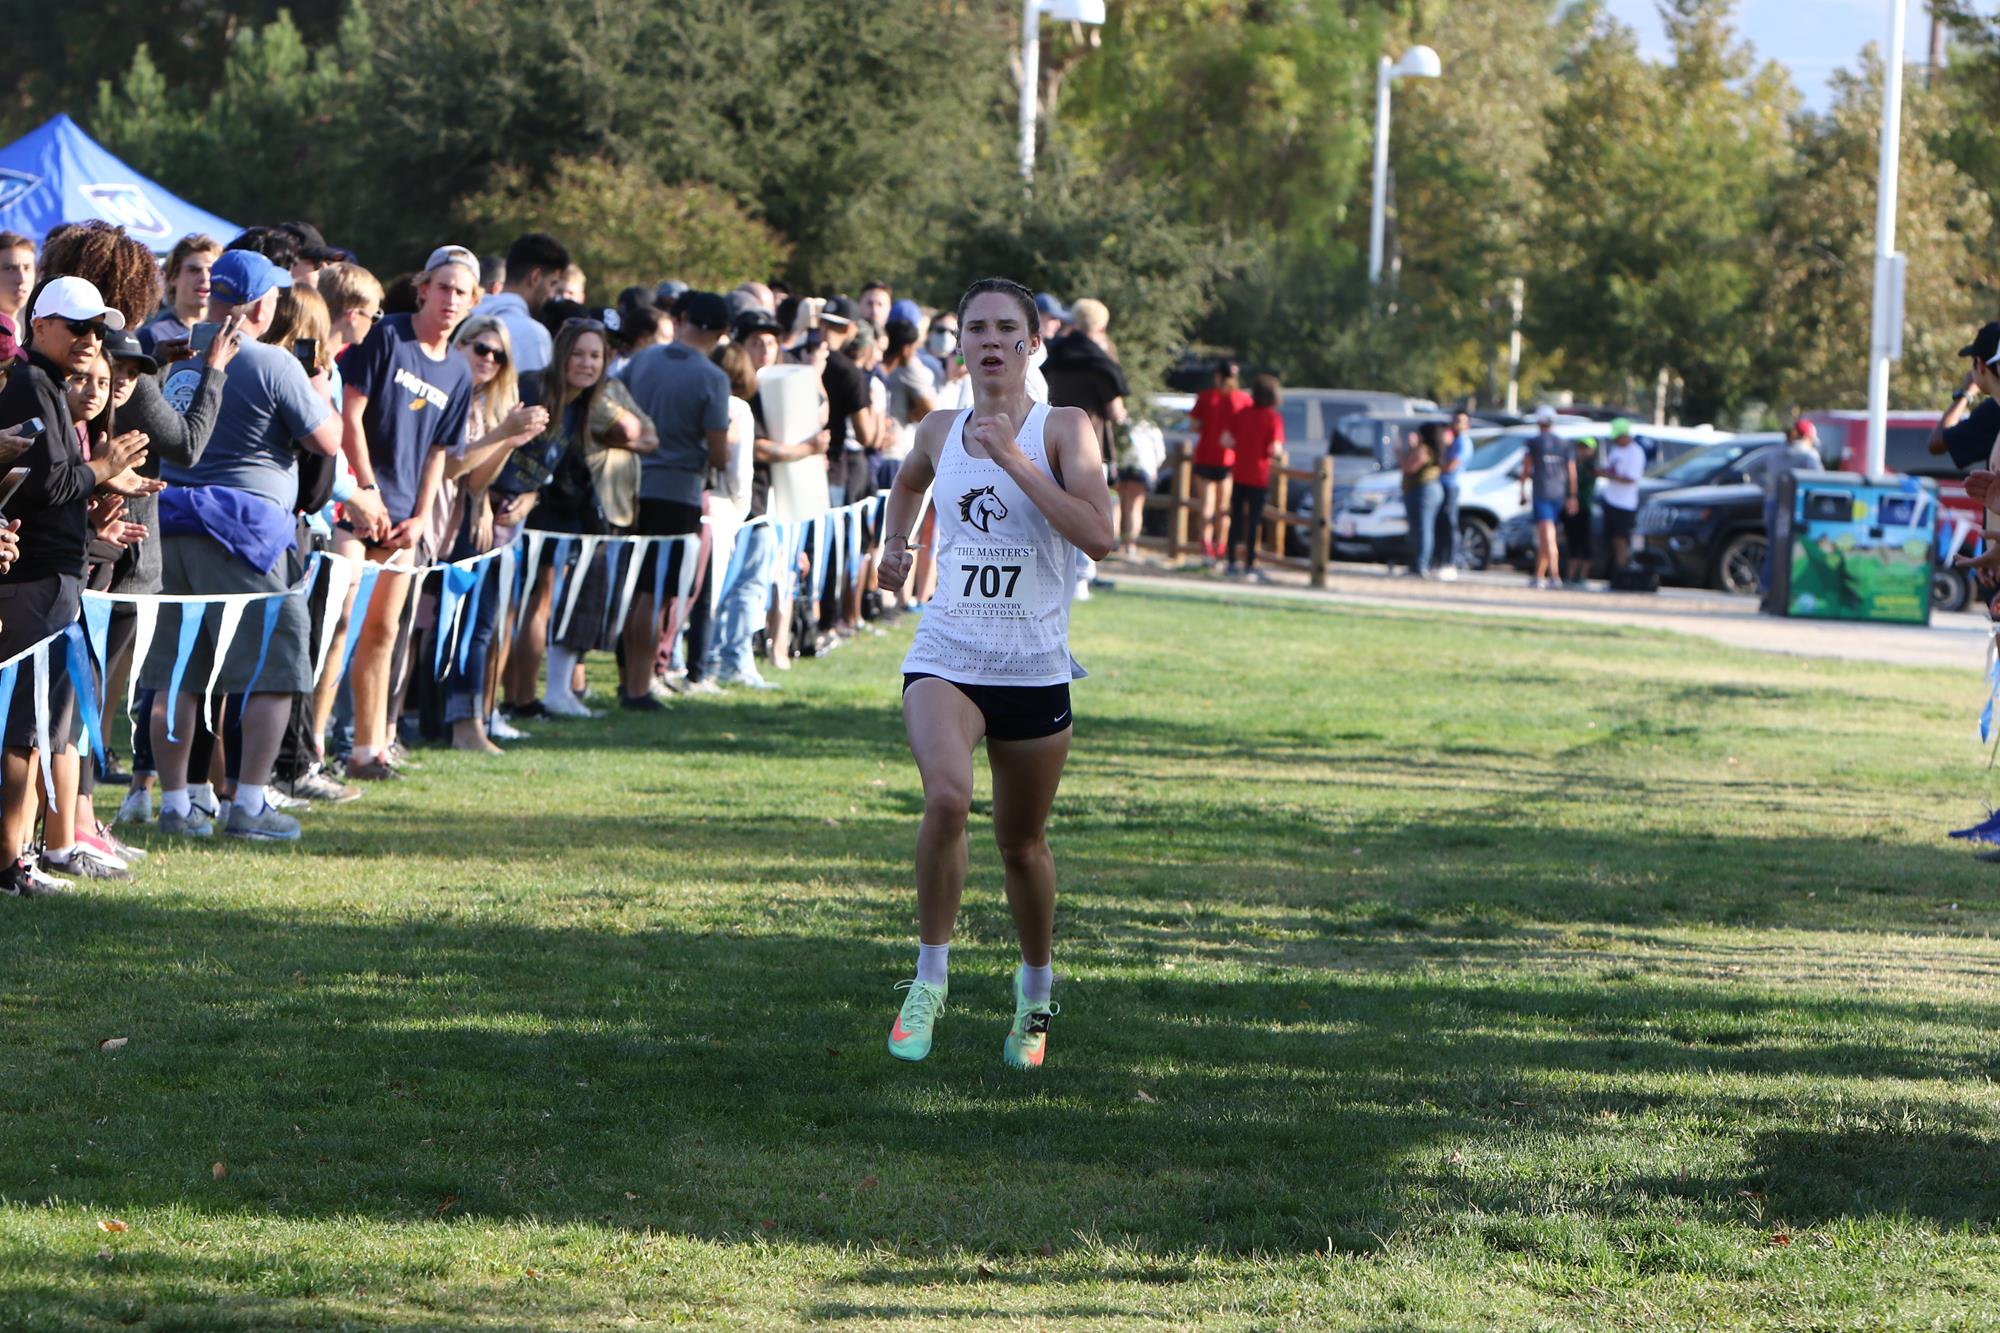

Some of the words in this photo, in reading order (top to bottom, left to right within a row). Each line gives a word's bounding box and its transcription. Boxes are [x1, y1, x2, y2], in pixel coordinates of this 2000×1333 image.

[956, 547, 975, 556] THE
[977, 547, 1030, 557] MASTER'S
[961, 565, 1021, 598] 707
